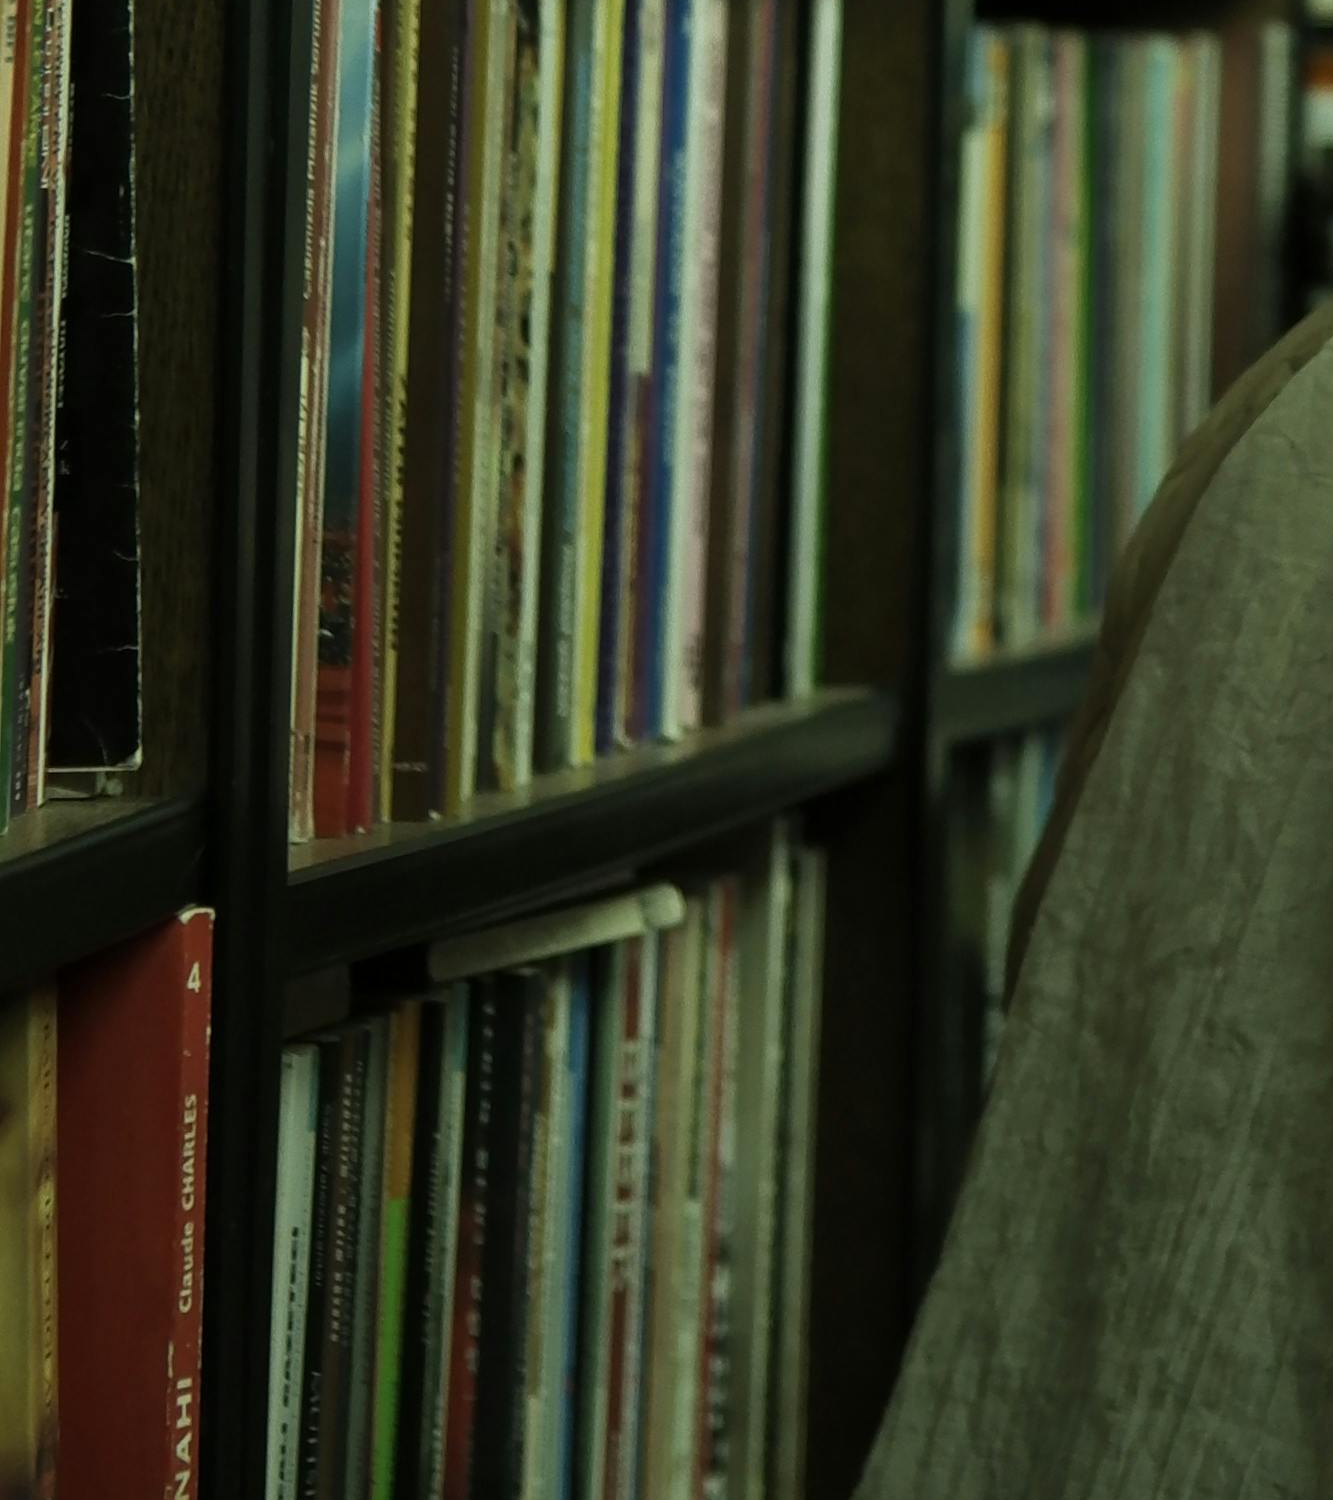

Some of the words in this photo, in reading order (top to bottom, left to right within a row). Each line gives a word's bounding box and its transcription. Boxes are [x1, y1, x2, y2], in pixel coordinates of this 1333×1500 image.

[186, 960, 202, 994] 4
[181, 1092, 198, 1212] CHARLES
[178, 1221, 195, 1315] Claude
